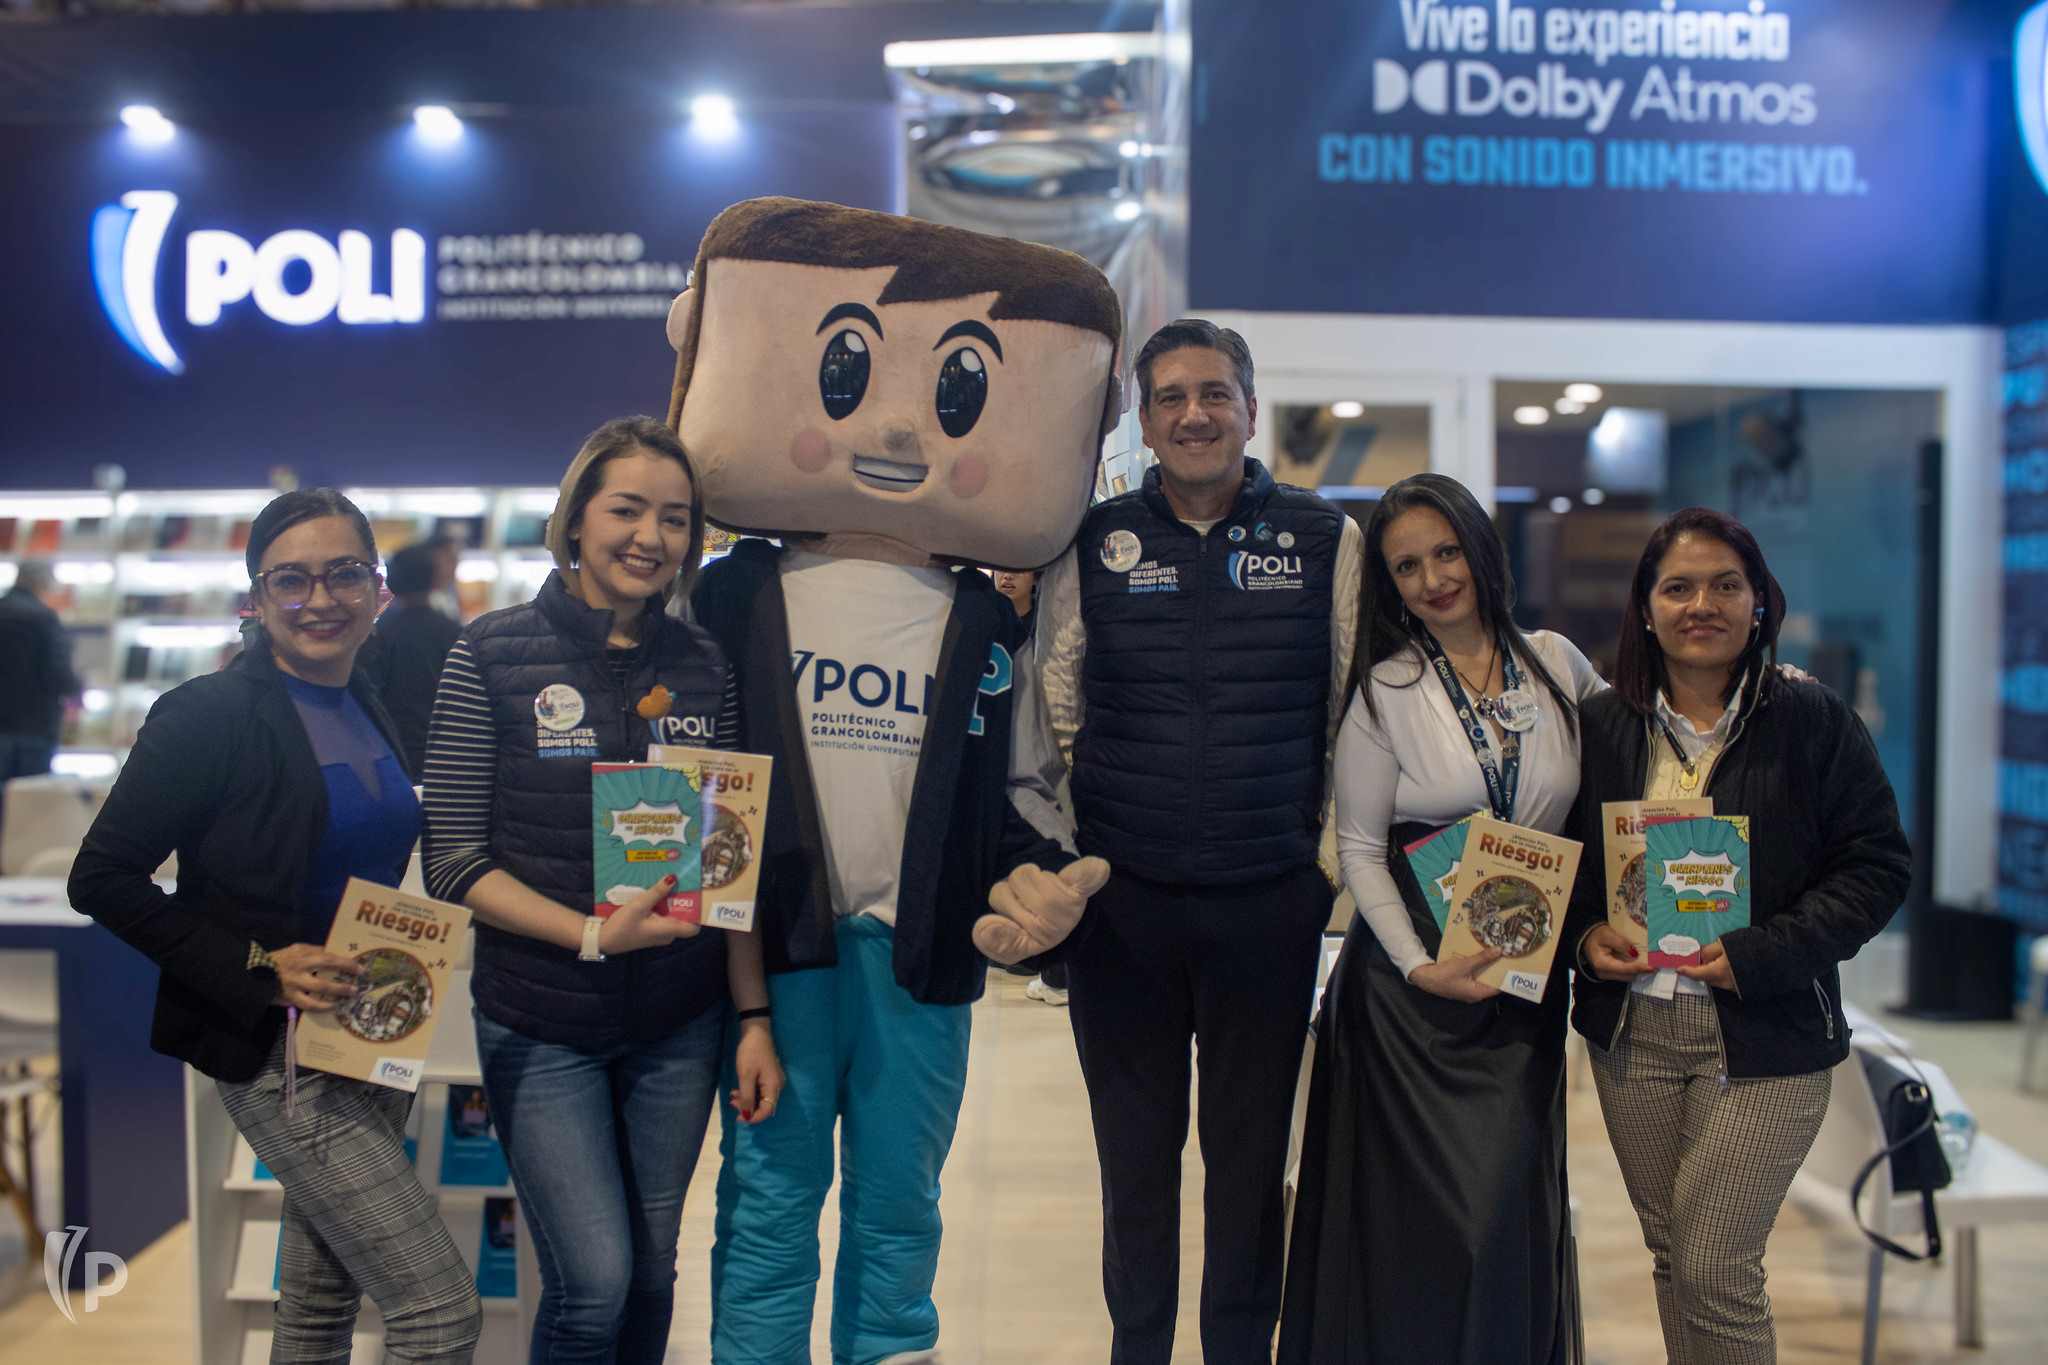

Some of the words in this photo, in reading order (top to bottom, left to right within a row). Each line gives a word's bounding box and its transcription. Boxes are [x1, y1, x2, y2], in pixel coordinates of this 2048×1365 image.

[1400, 0, 1488, 51] Vive
[1456, 60, 1624, 133] Dolby
[1629, 65, 1818, 125] Atmos
[1319, 134, 1412, 183] CON
[1423, 135, 1595, 188] SONIDO
[1605, 139, 1869, 196] INMERSIVO.
[186, 228, 425, 325] POLI
[1247, 555, 1302, 575] POLI
[666, 717, 715, 738] POLI
[811, 726, 920, 745] GRANCOLOMBIAN
[812, 711, 896, 729] POLITÉCNICO
[867, 744, 919, 757] UNIVERSITAR
[1479, 832, 1564, 873] Riesgo!
[355, 900, 452, 944] Riesgo!
